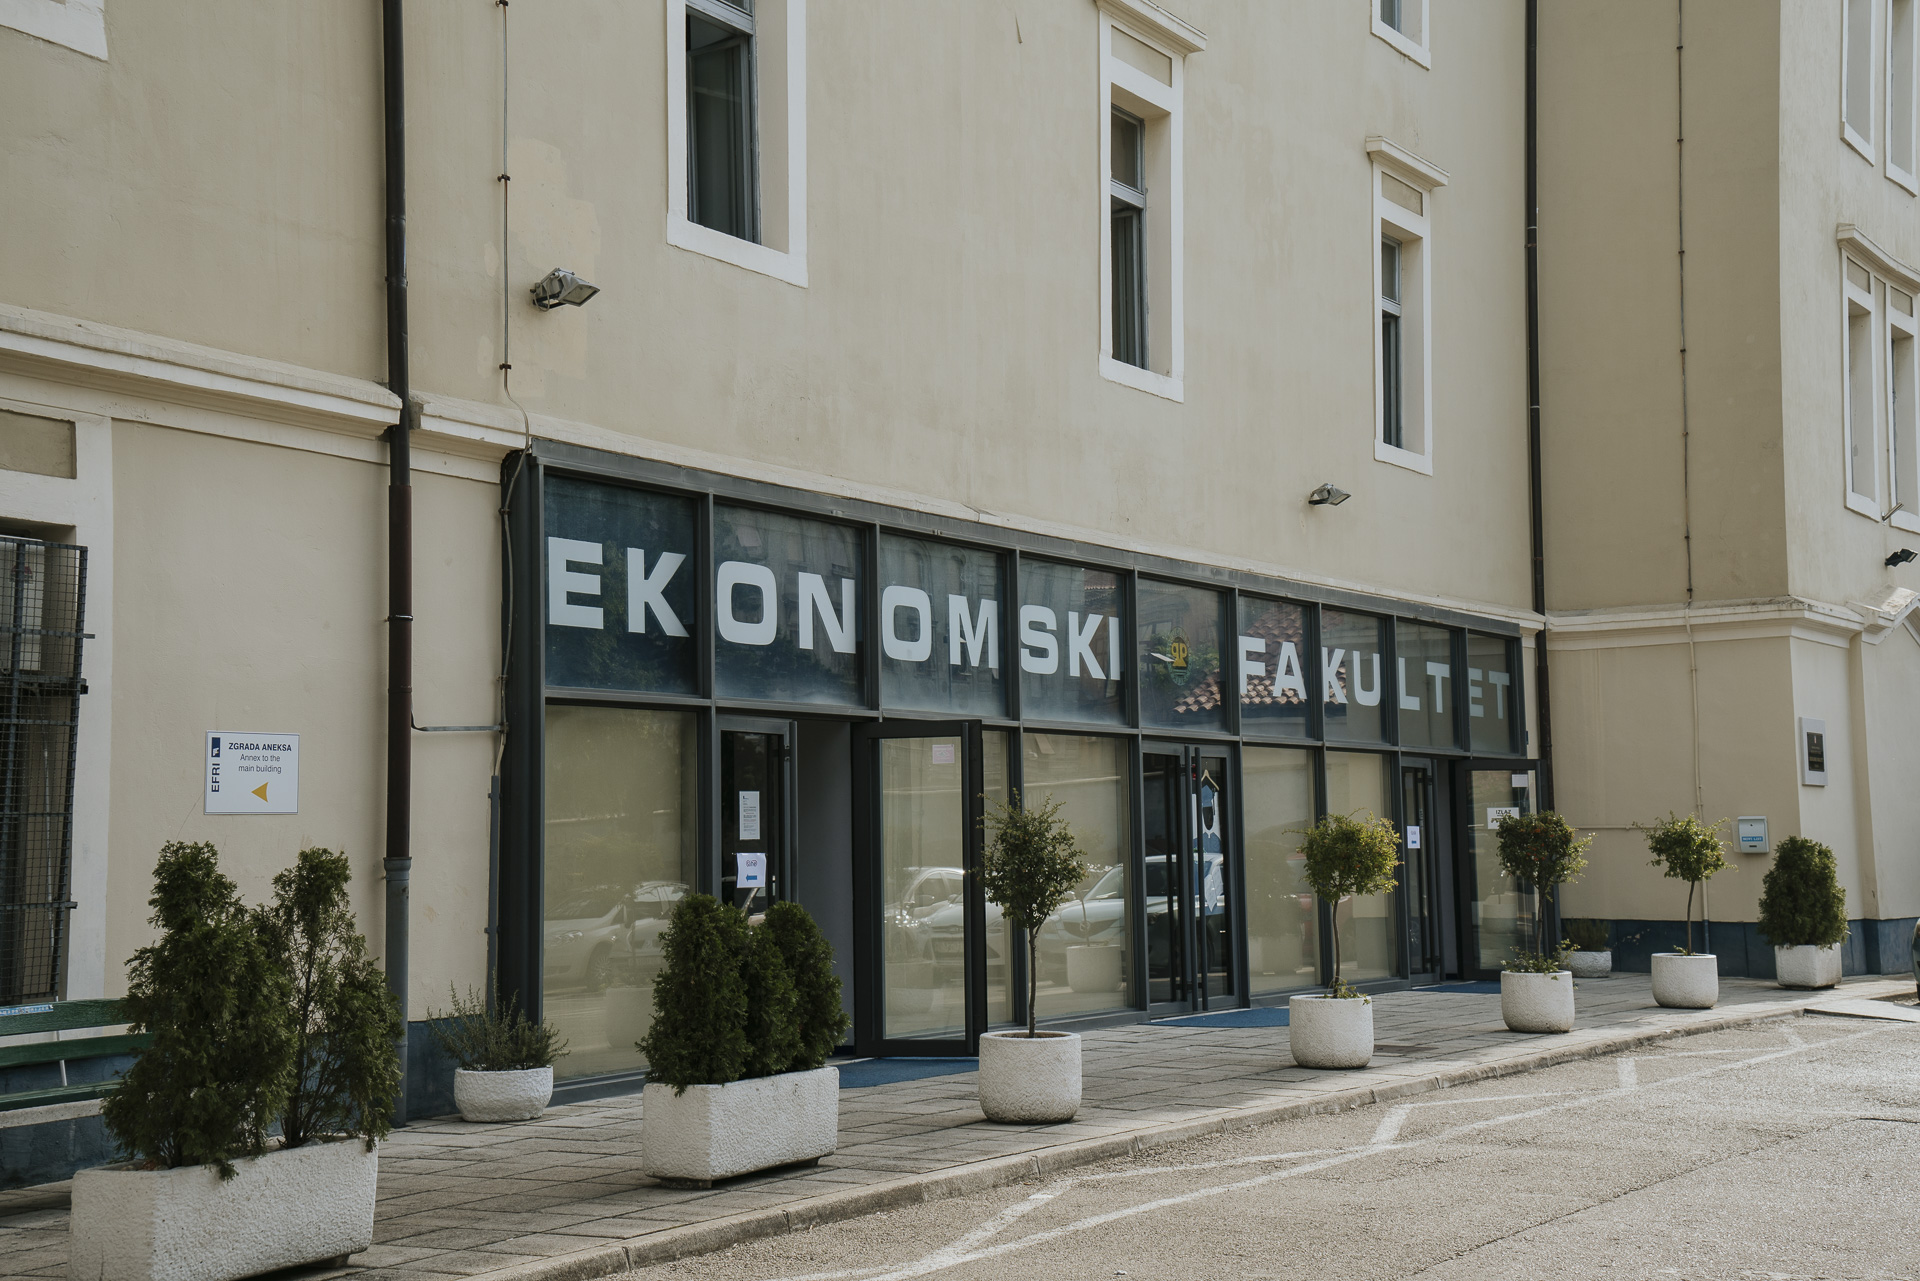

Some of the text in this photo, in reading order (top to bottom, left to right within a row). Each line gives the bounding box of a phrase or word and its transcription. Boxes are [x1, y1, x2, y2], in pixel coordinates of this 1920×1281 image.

[548, 537, 1120, 681] EKONOMSKI
[1239, 636, 1510, 720] FAKULTET
[228, 742, 292, 752] ZGRADA ANEKSA
[212, 763, 220, 792] EFRI
[256, 765, 282, 774] building
